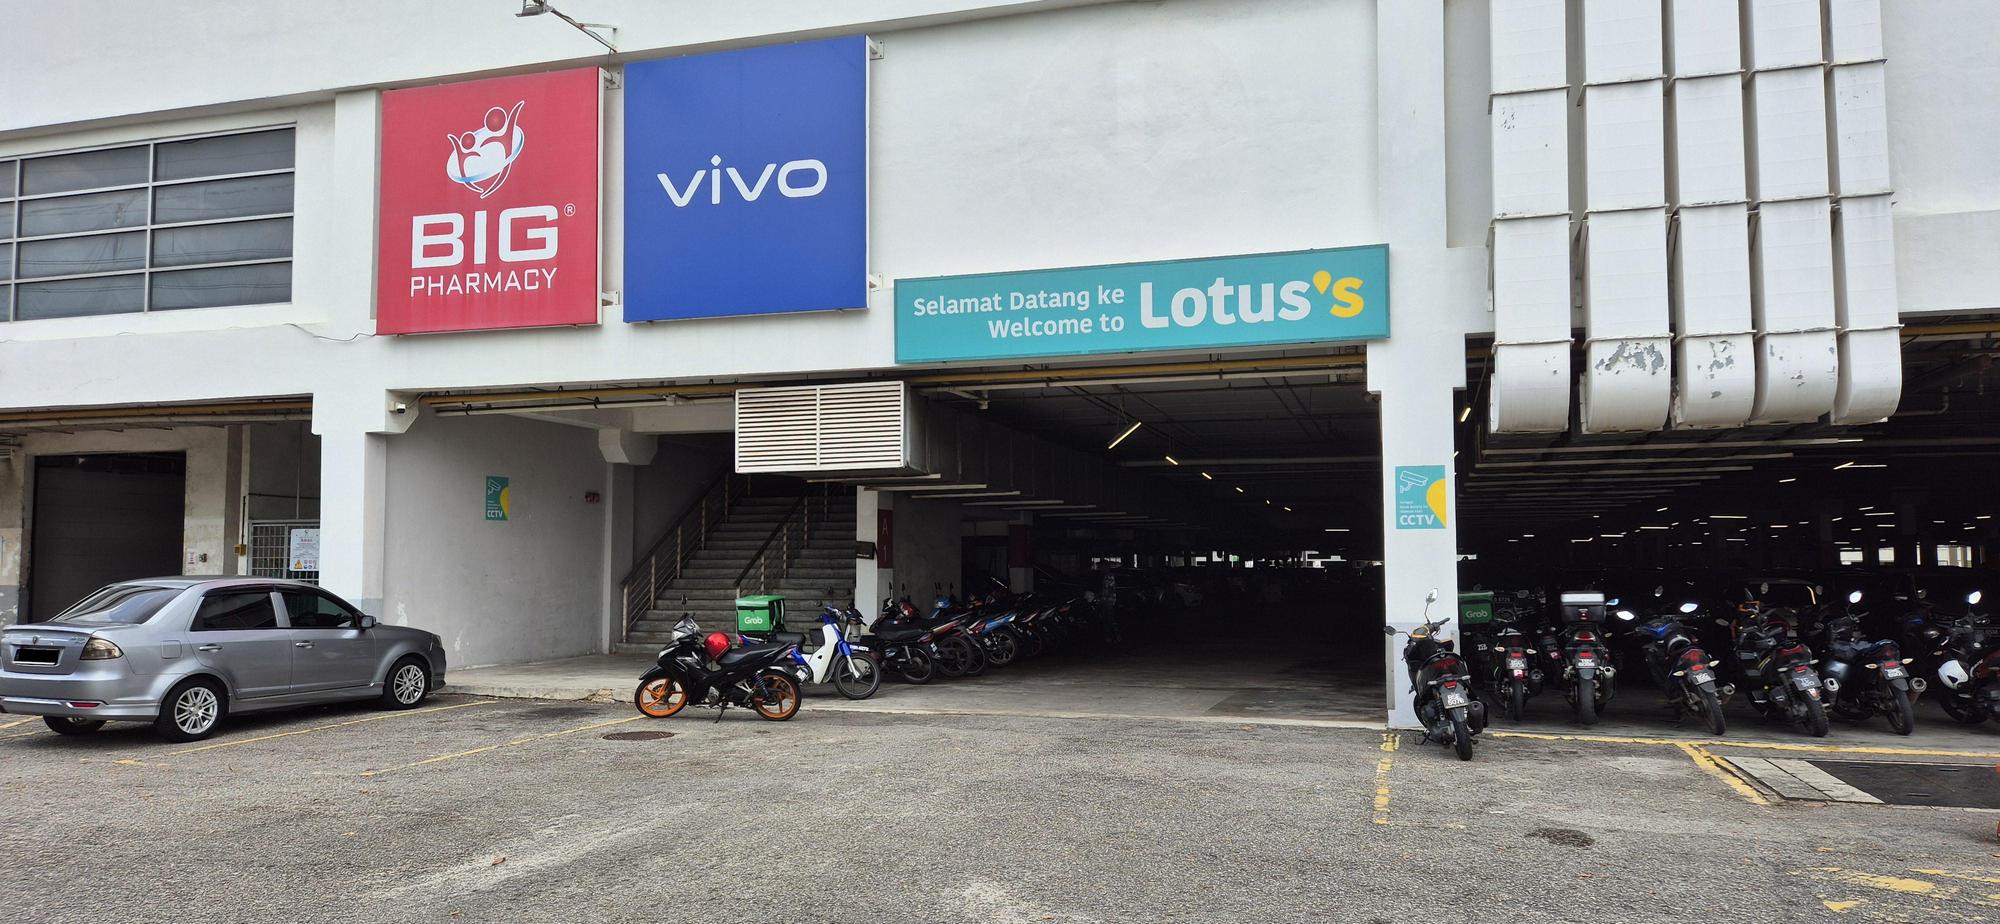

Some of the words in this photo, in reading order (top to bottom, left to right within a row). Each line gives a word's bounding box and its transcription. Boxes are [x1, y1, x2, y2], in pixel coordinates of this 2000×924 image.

[657, 154, 828, 208] vivo
[411, 205, 559, 268] BIG
[411, 267, 558, 297] PHARMACY
[913, 293, 1003, 317] Selamat
[1010, 287, 1091, 316] Datang
[1098, 285, 1126, 306] ke
[1140, 270, 1366, 330] Lotus's
[988, 316, 1093, 339] Welcome
[1099, 313, 1126, 334] to
[487, 510, 503, 518] CCTV
[1400, 514, 1435, 526] CCTV
[744, 616, 763, 624] Grab
[1465, 609, 1488, 619] Grab
